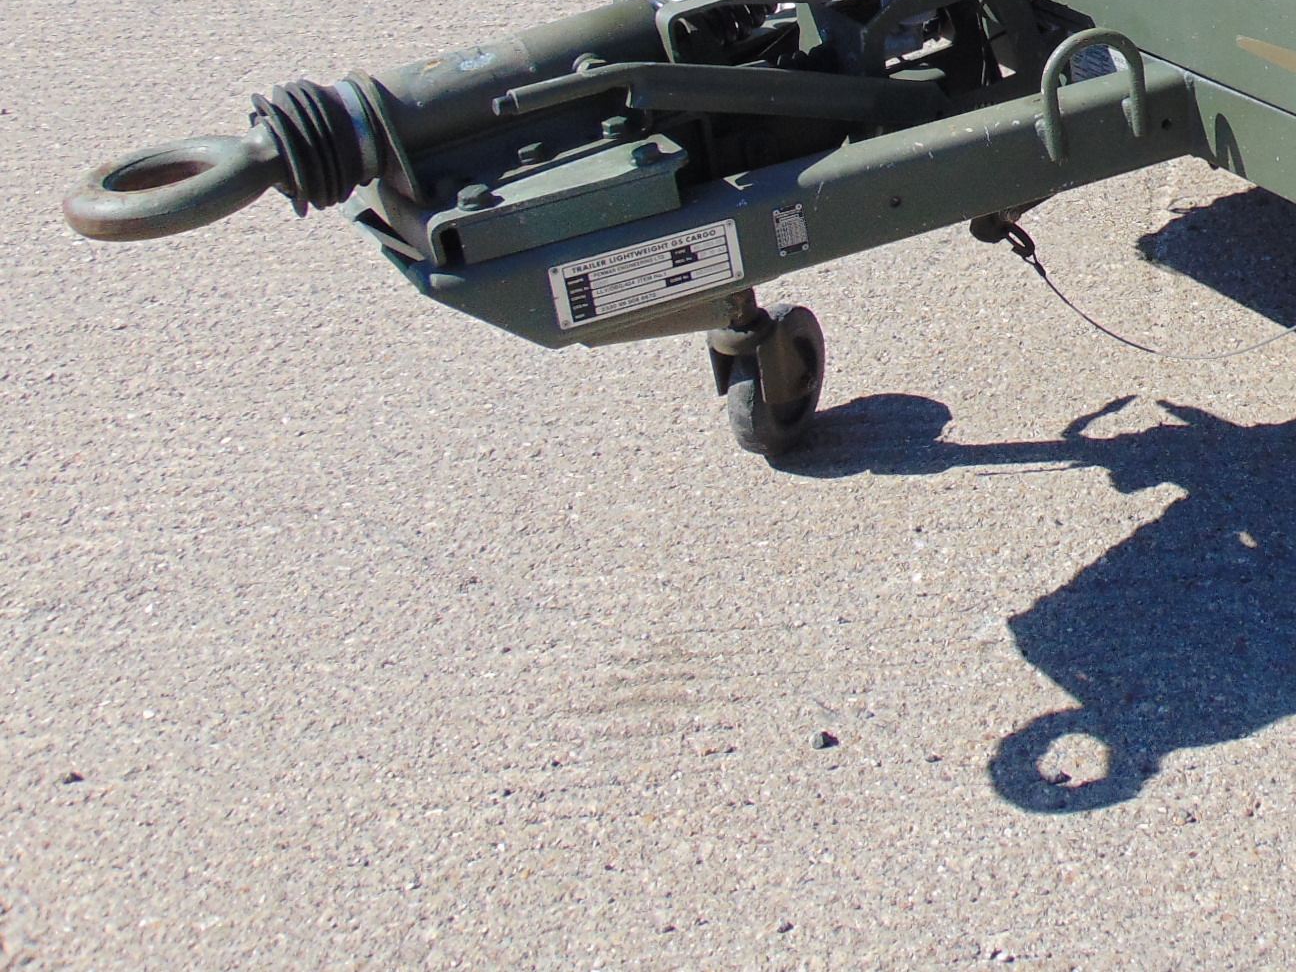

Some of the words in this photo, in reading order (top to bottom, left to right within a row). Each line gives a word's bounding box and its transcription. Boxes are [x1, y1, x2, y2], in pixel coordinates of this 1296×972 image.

[572, 259, 607, 274] TRAILER
[609, 241, 669, 265] LIGHTWEIGHT
[671, 238, 684, 247] GS
[685, 229, 716, 244] CARGO
[593, 267, 617, 279] PENMAN
[617, 257, 652, 272] ENGINEERING
